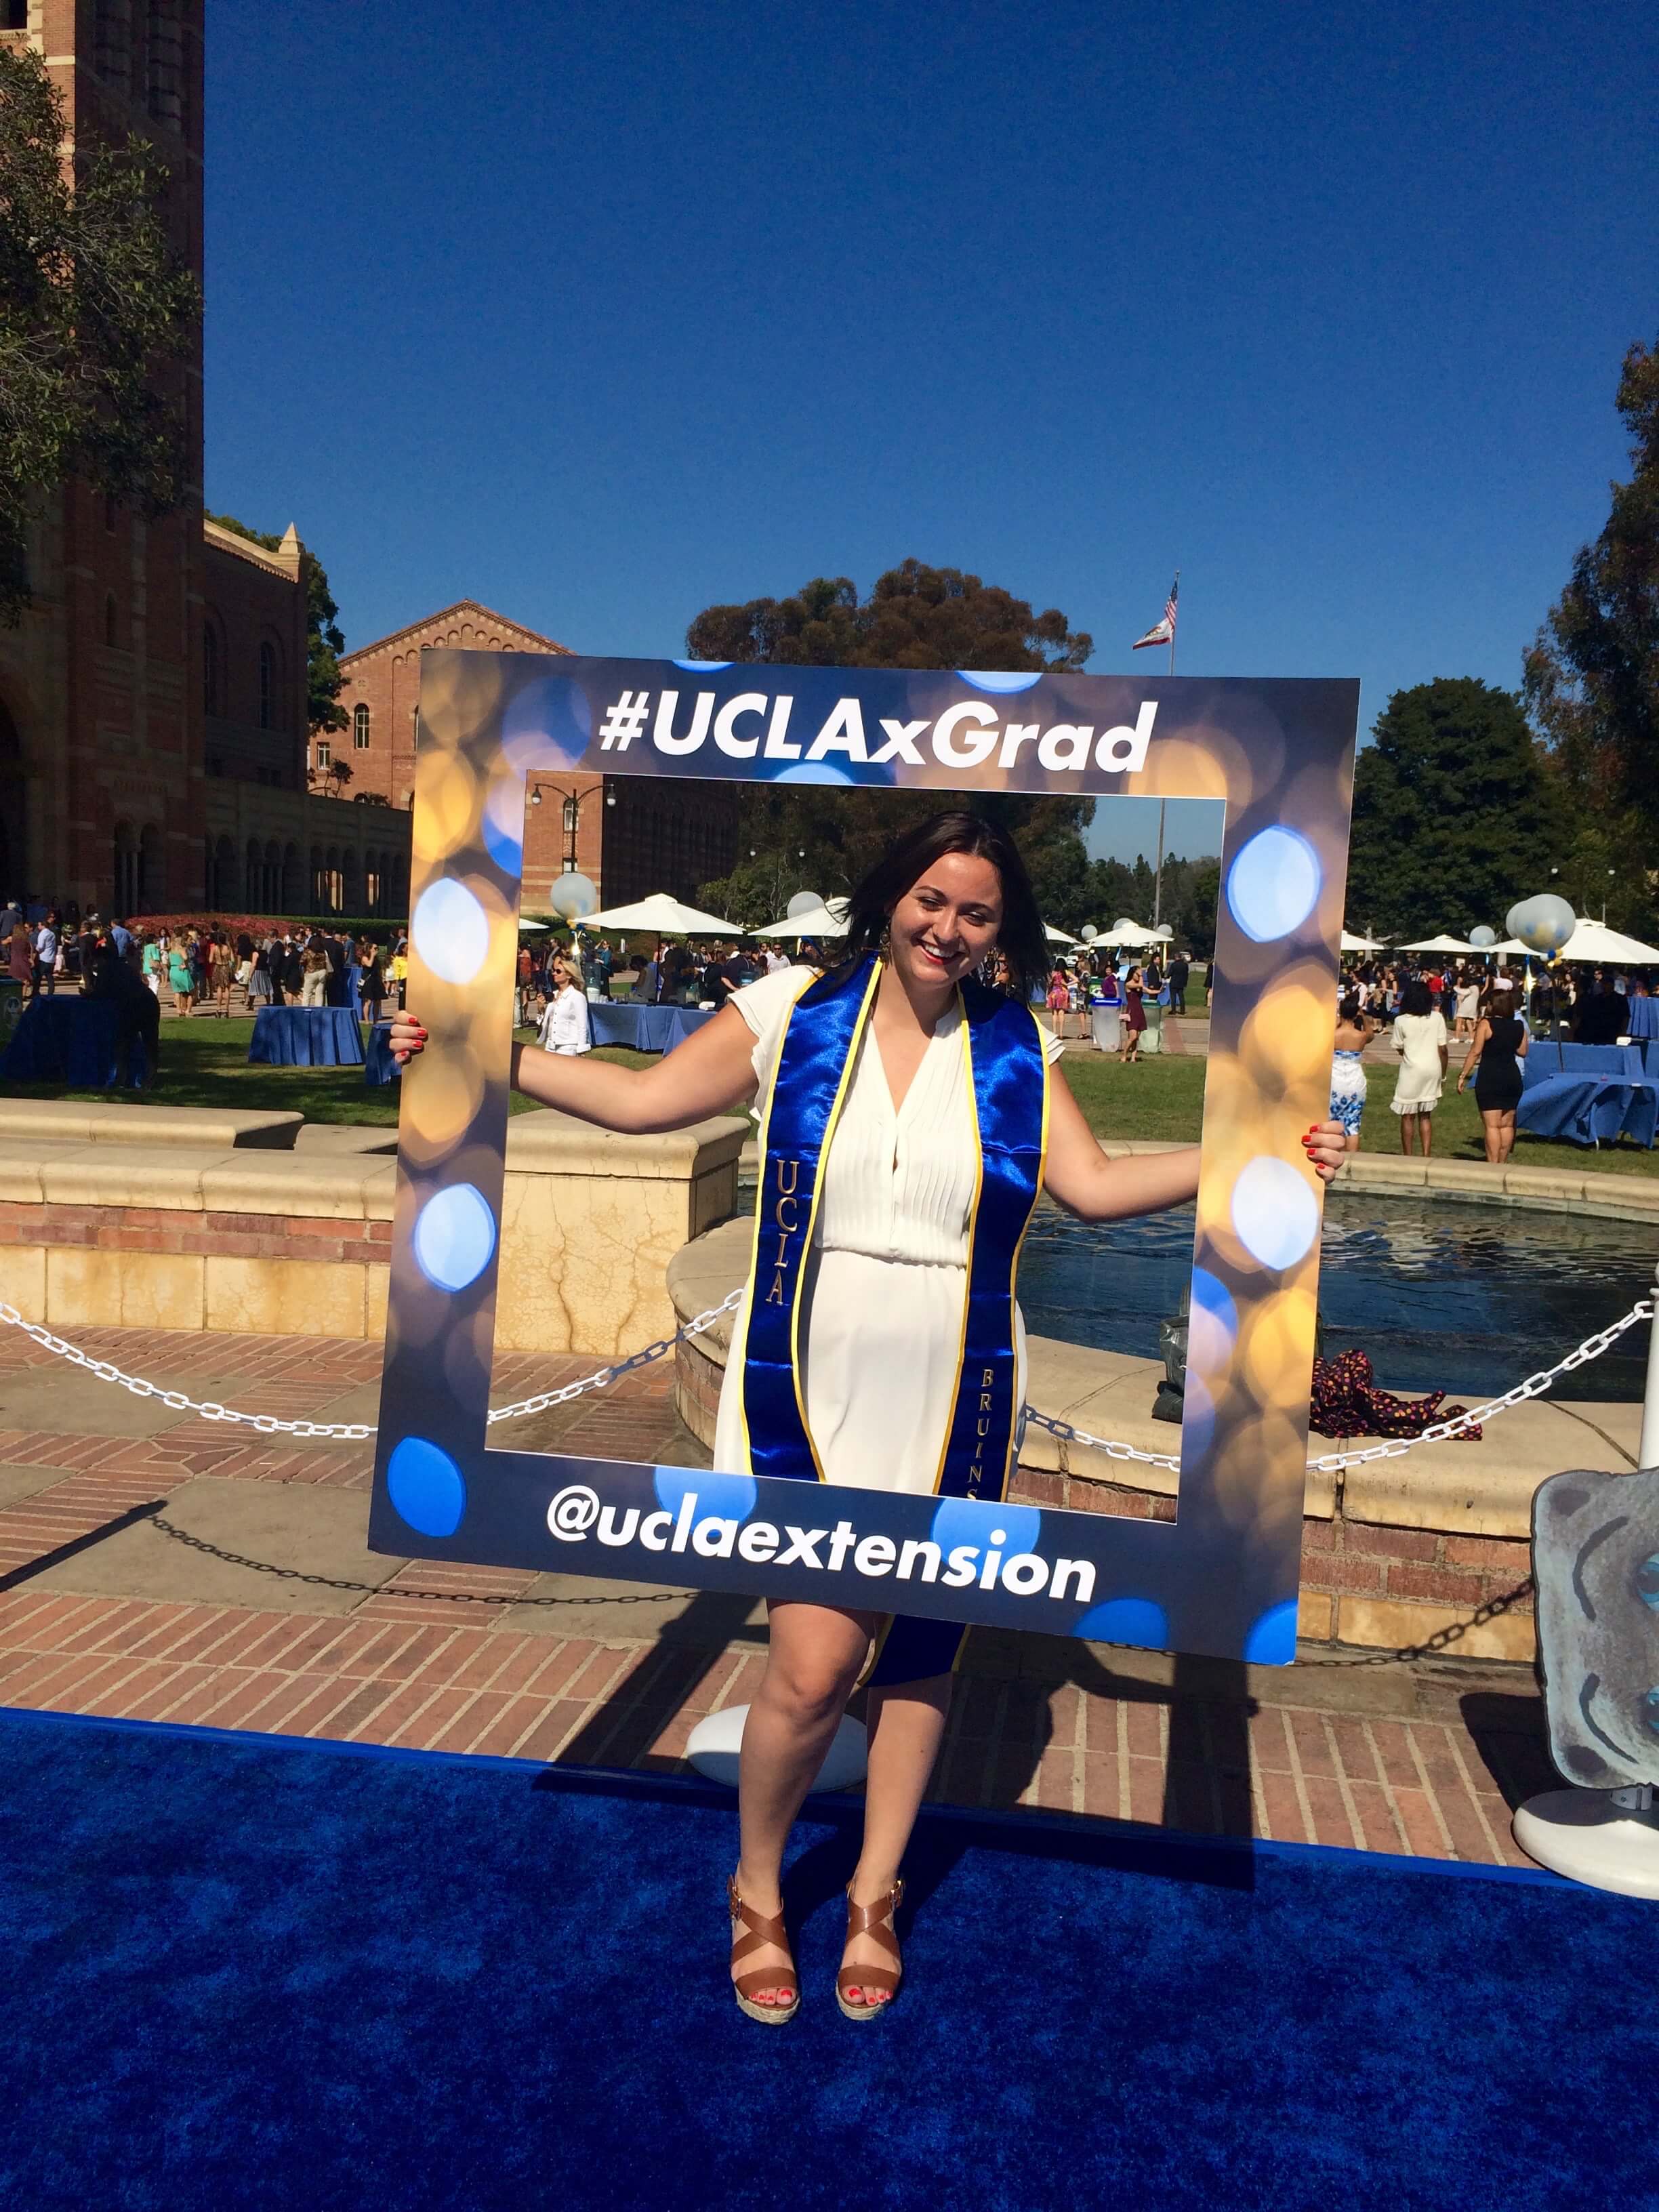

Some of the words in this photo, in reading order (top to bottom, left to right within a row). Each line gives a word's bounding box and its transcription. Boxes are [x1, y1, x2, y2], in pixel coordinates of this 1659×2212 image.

[599, 691, 1158, 773] #UCLAxGrad
[766, 1160, 799, 1305] UCLA
[547, 1484, 1097, 1601] @uclaextension
